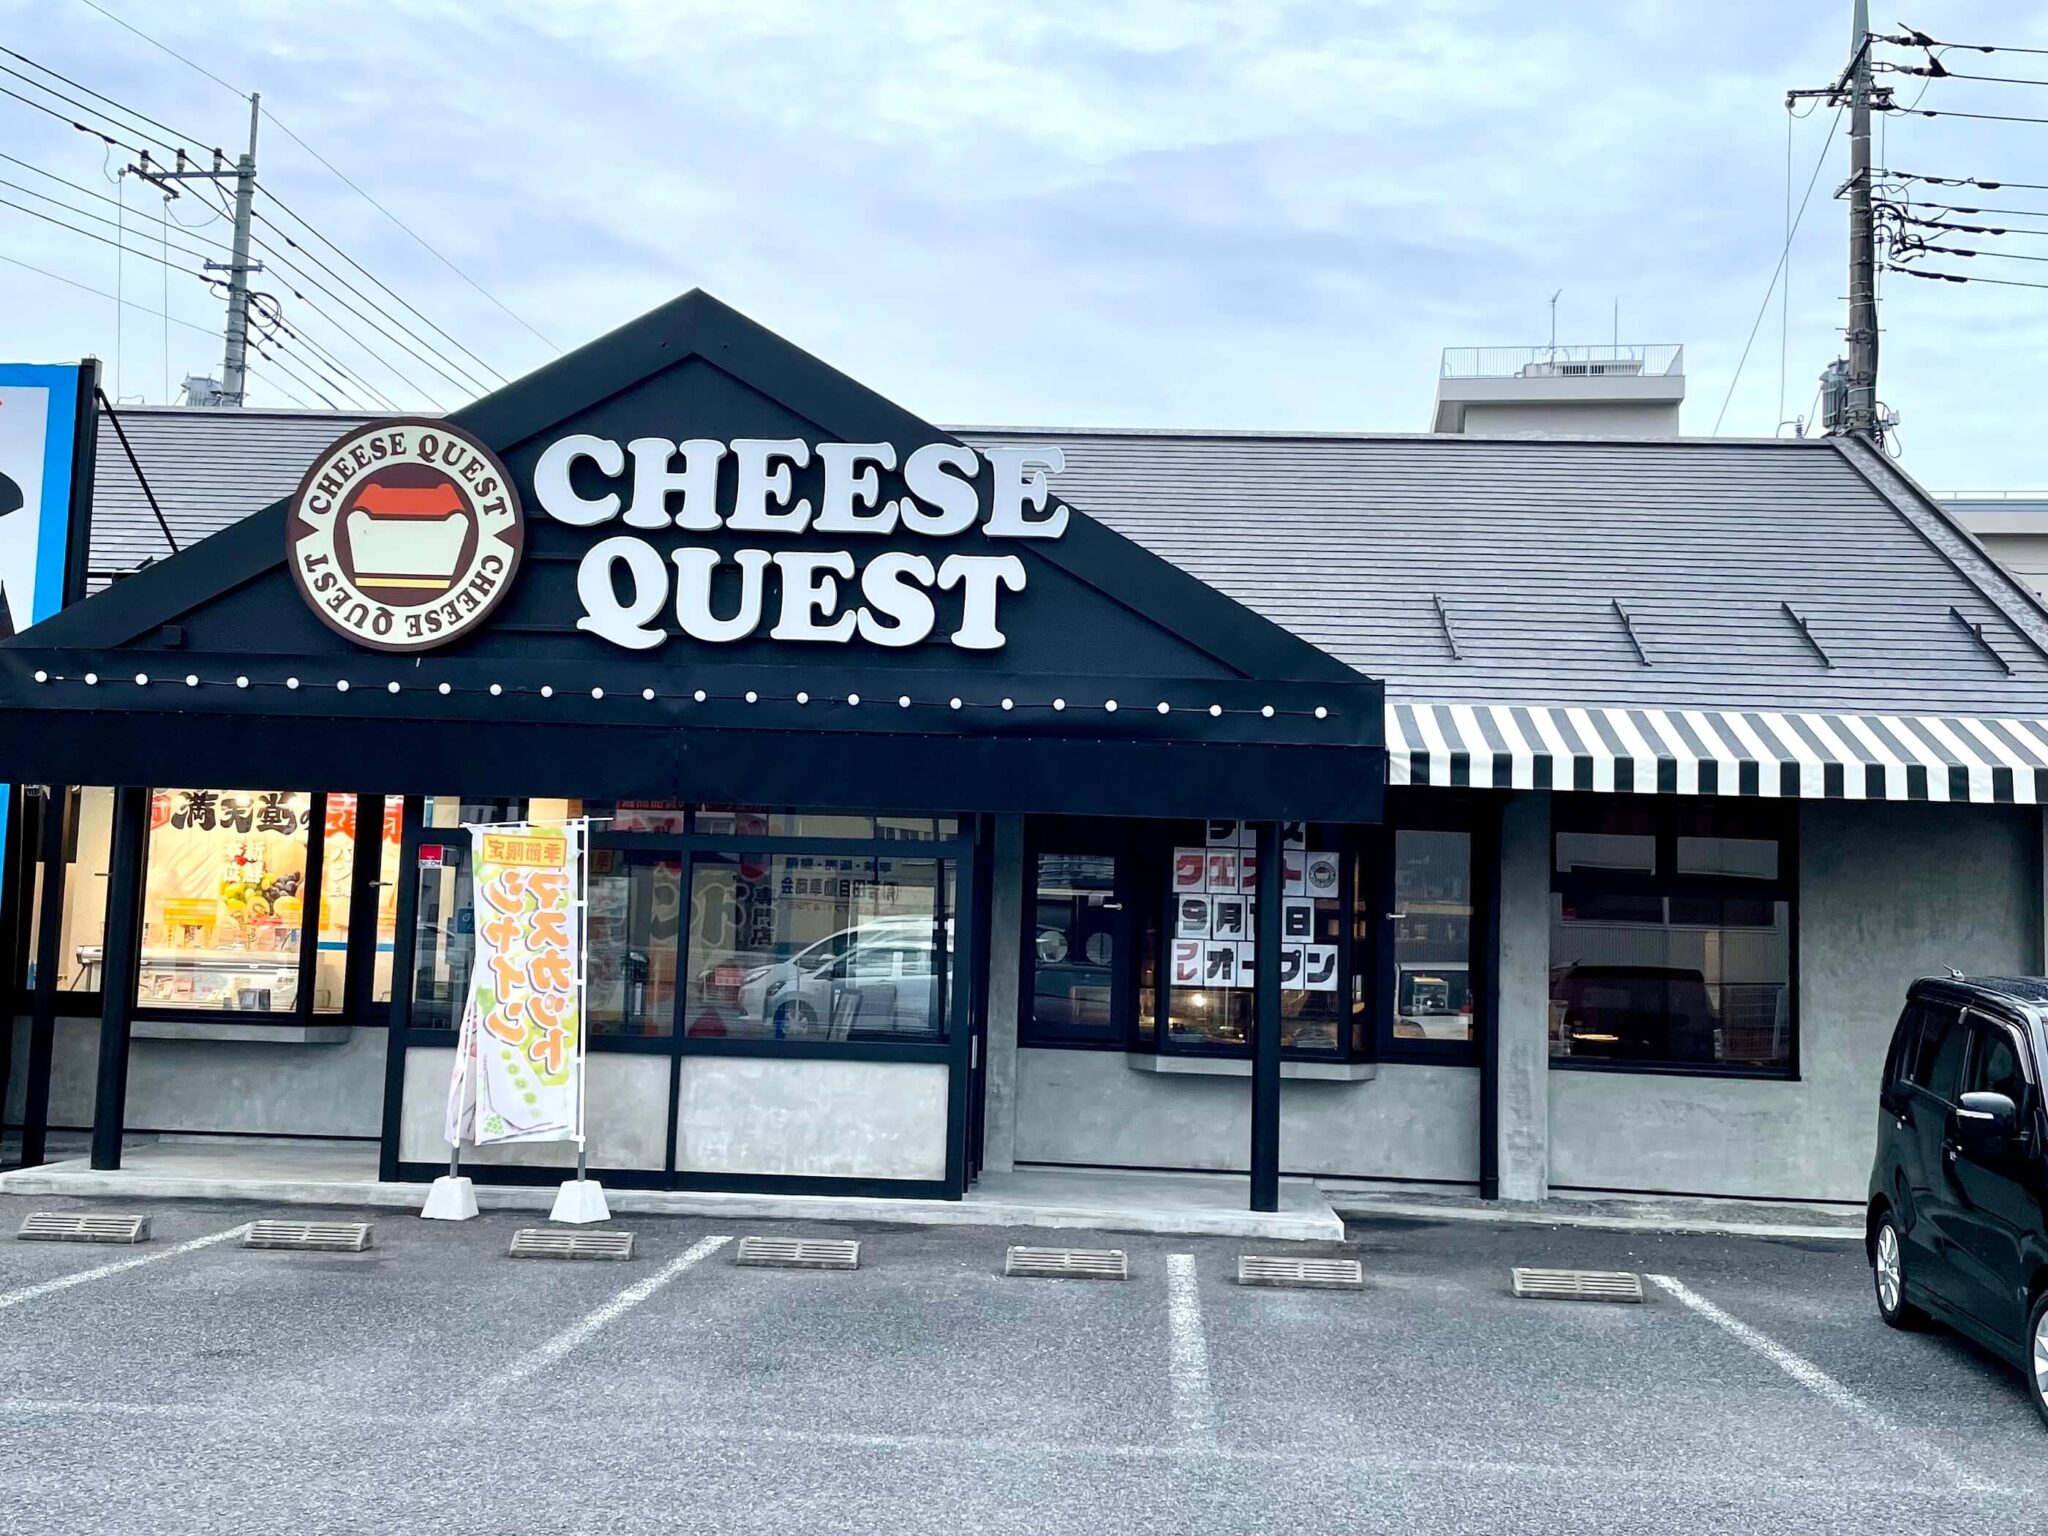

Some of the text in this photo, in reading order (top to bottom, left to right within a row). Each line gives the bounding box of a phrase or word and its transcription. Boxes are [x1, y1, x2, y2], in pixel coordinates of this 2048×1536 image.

[309, 432, 507, 516] CHEESE QUEST
[534, 434, 1069, 538] CHEESE
[304, 554, 504, 637] CHEESE QUEST
[577, 536, 1026, 649] QUEST
[1182, 899, 1311, 936] 9月日
